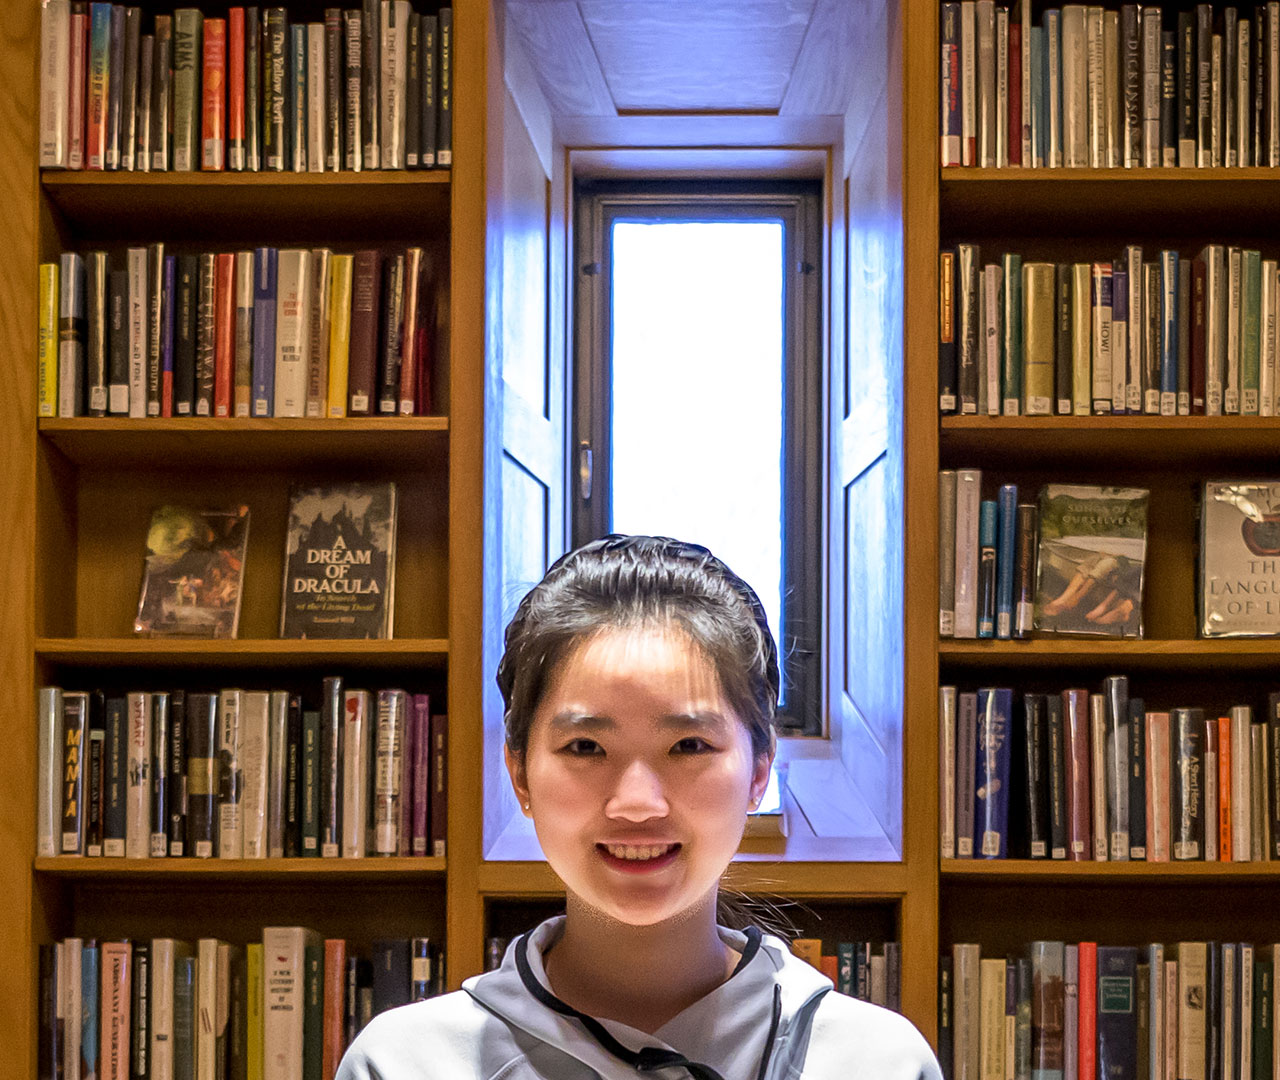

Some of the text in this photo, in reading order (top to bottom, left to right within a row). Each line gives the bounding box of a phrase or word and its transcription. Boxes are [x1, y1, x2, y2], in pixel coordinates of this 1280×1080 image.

[175, 32, 193, 71] ARMS
[273, 32, 284, 55] The
[273, 56, 284, 93] Yellow
[1127, 39, 1139, 137] DICKINSON
[333, 536, 346, 550] A
[307, 549, 372, 564] DREAM
[325, 565, 350, 579] OF
[293, 579, 380, 594] DRACULA
[1227, 601, 1256, 616] OF
[65, 729, 81, 817] MANIA
[1190, 764, 1198, 787] Short
[1190, 789, 1199, 818] History
